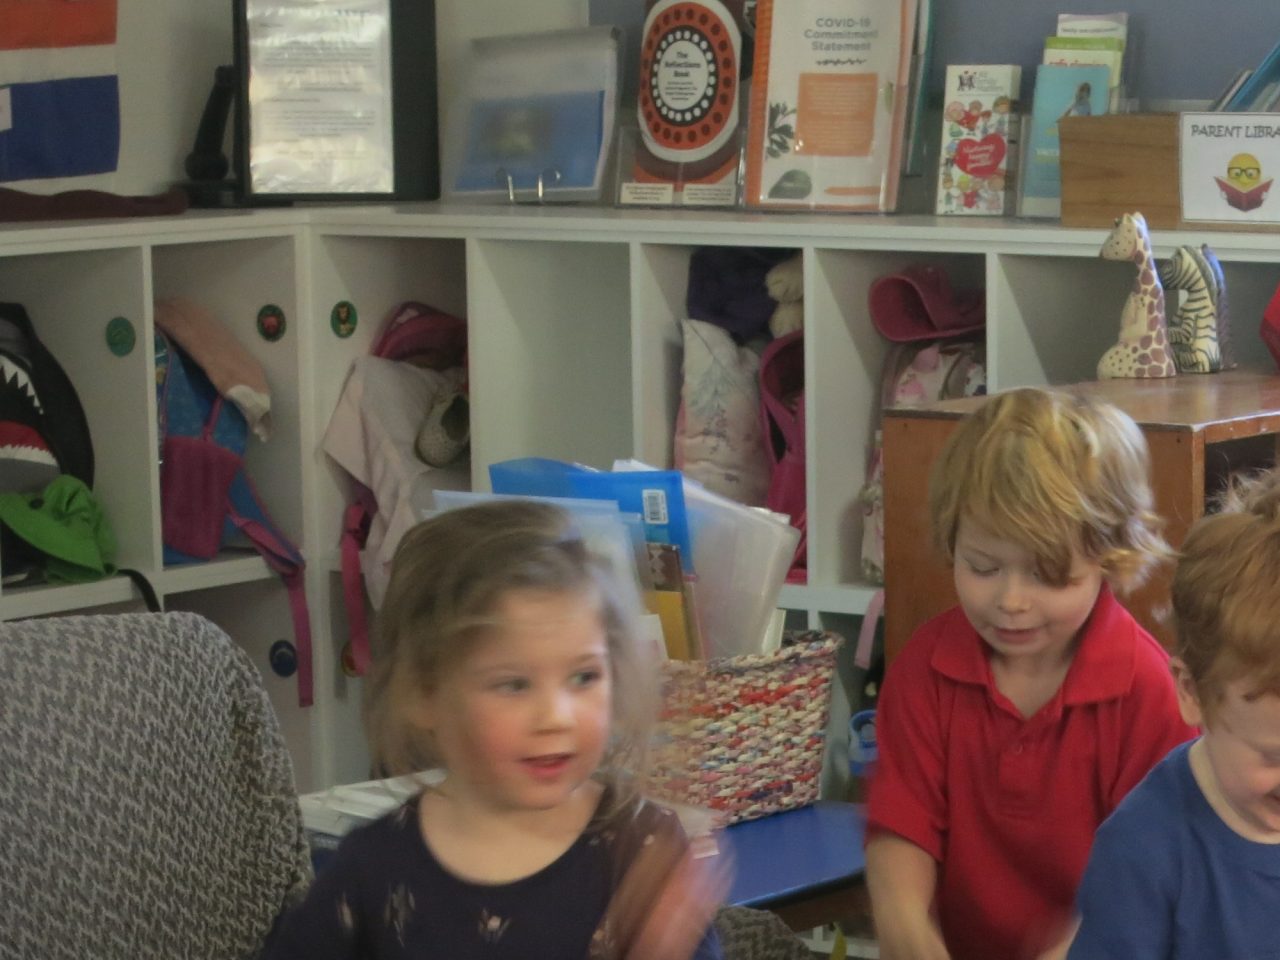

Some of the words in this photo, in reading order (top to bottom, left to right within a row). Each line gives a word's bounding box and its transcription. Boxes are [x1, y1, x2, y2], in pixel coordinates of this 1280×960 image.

[814, 17, 871, 28] COVID-19
[803, 29, 879, 39] Commitment
[811, 41, 871, 52] Statement
[1191, 124, 1242, 138] PARENT
